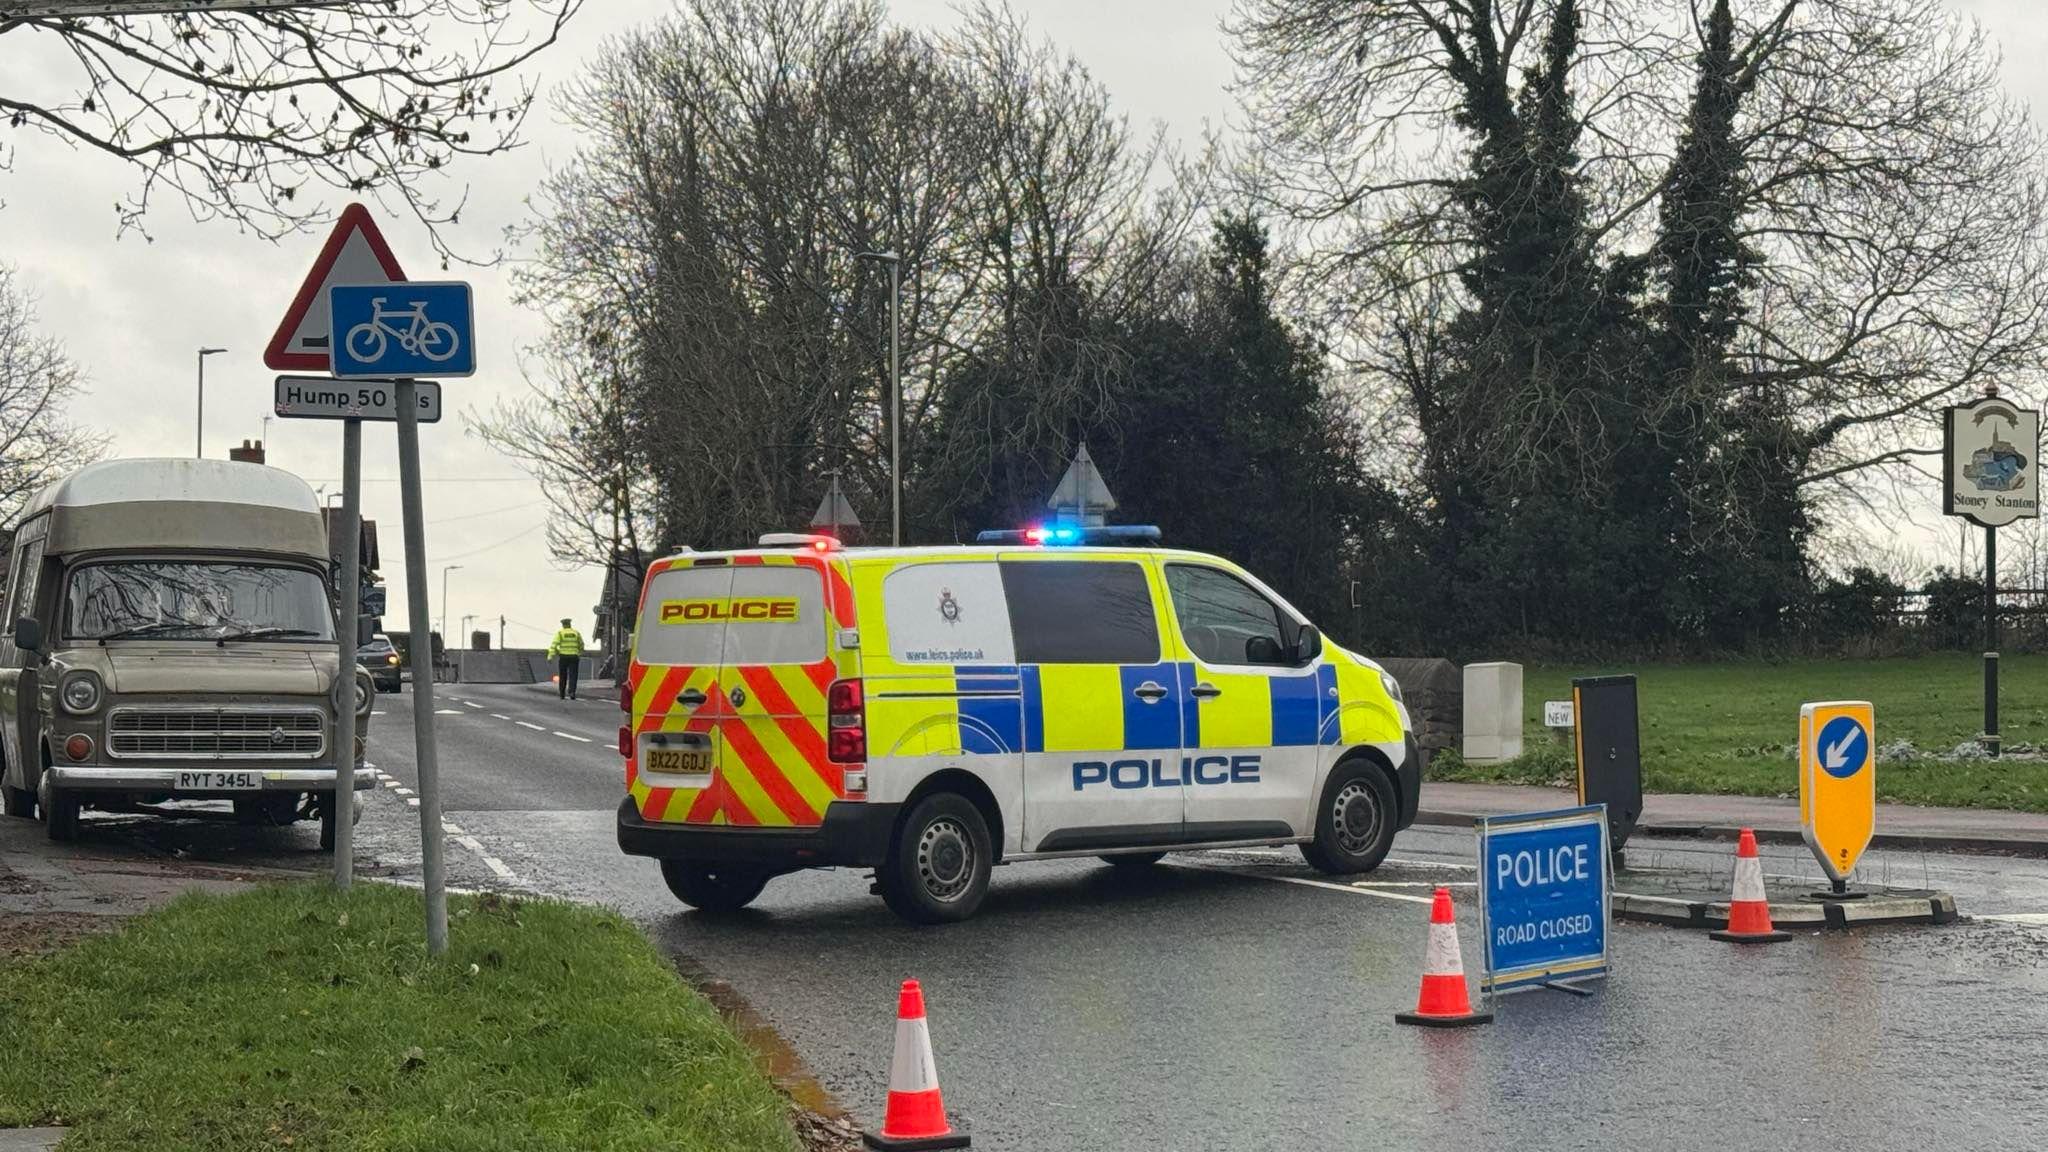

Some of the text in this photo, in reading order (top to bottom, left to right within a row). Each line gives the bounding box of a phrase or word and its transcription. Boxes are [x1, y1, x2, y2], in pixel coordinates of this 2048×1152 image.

[287, 387, 350, 408] Hump
[358, 389, 387, 407] 50
[1954, 493, 2035, 509] Stoney Stanton
[662, 602, 796, 621] POLICE
[1548, 712, 1569, 725] NEW
[650, 751, 706, 770] BX22 GDJ
[181, 773, 255, 787] RYT 345L
[1072, 755, 1261, 791] POLICE
[1497, 844, 1589, 890] POLICE
[1497, 914, 1593, 947] ROAD CLOSED
